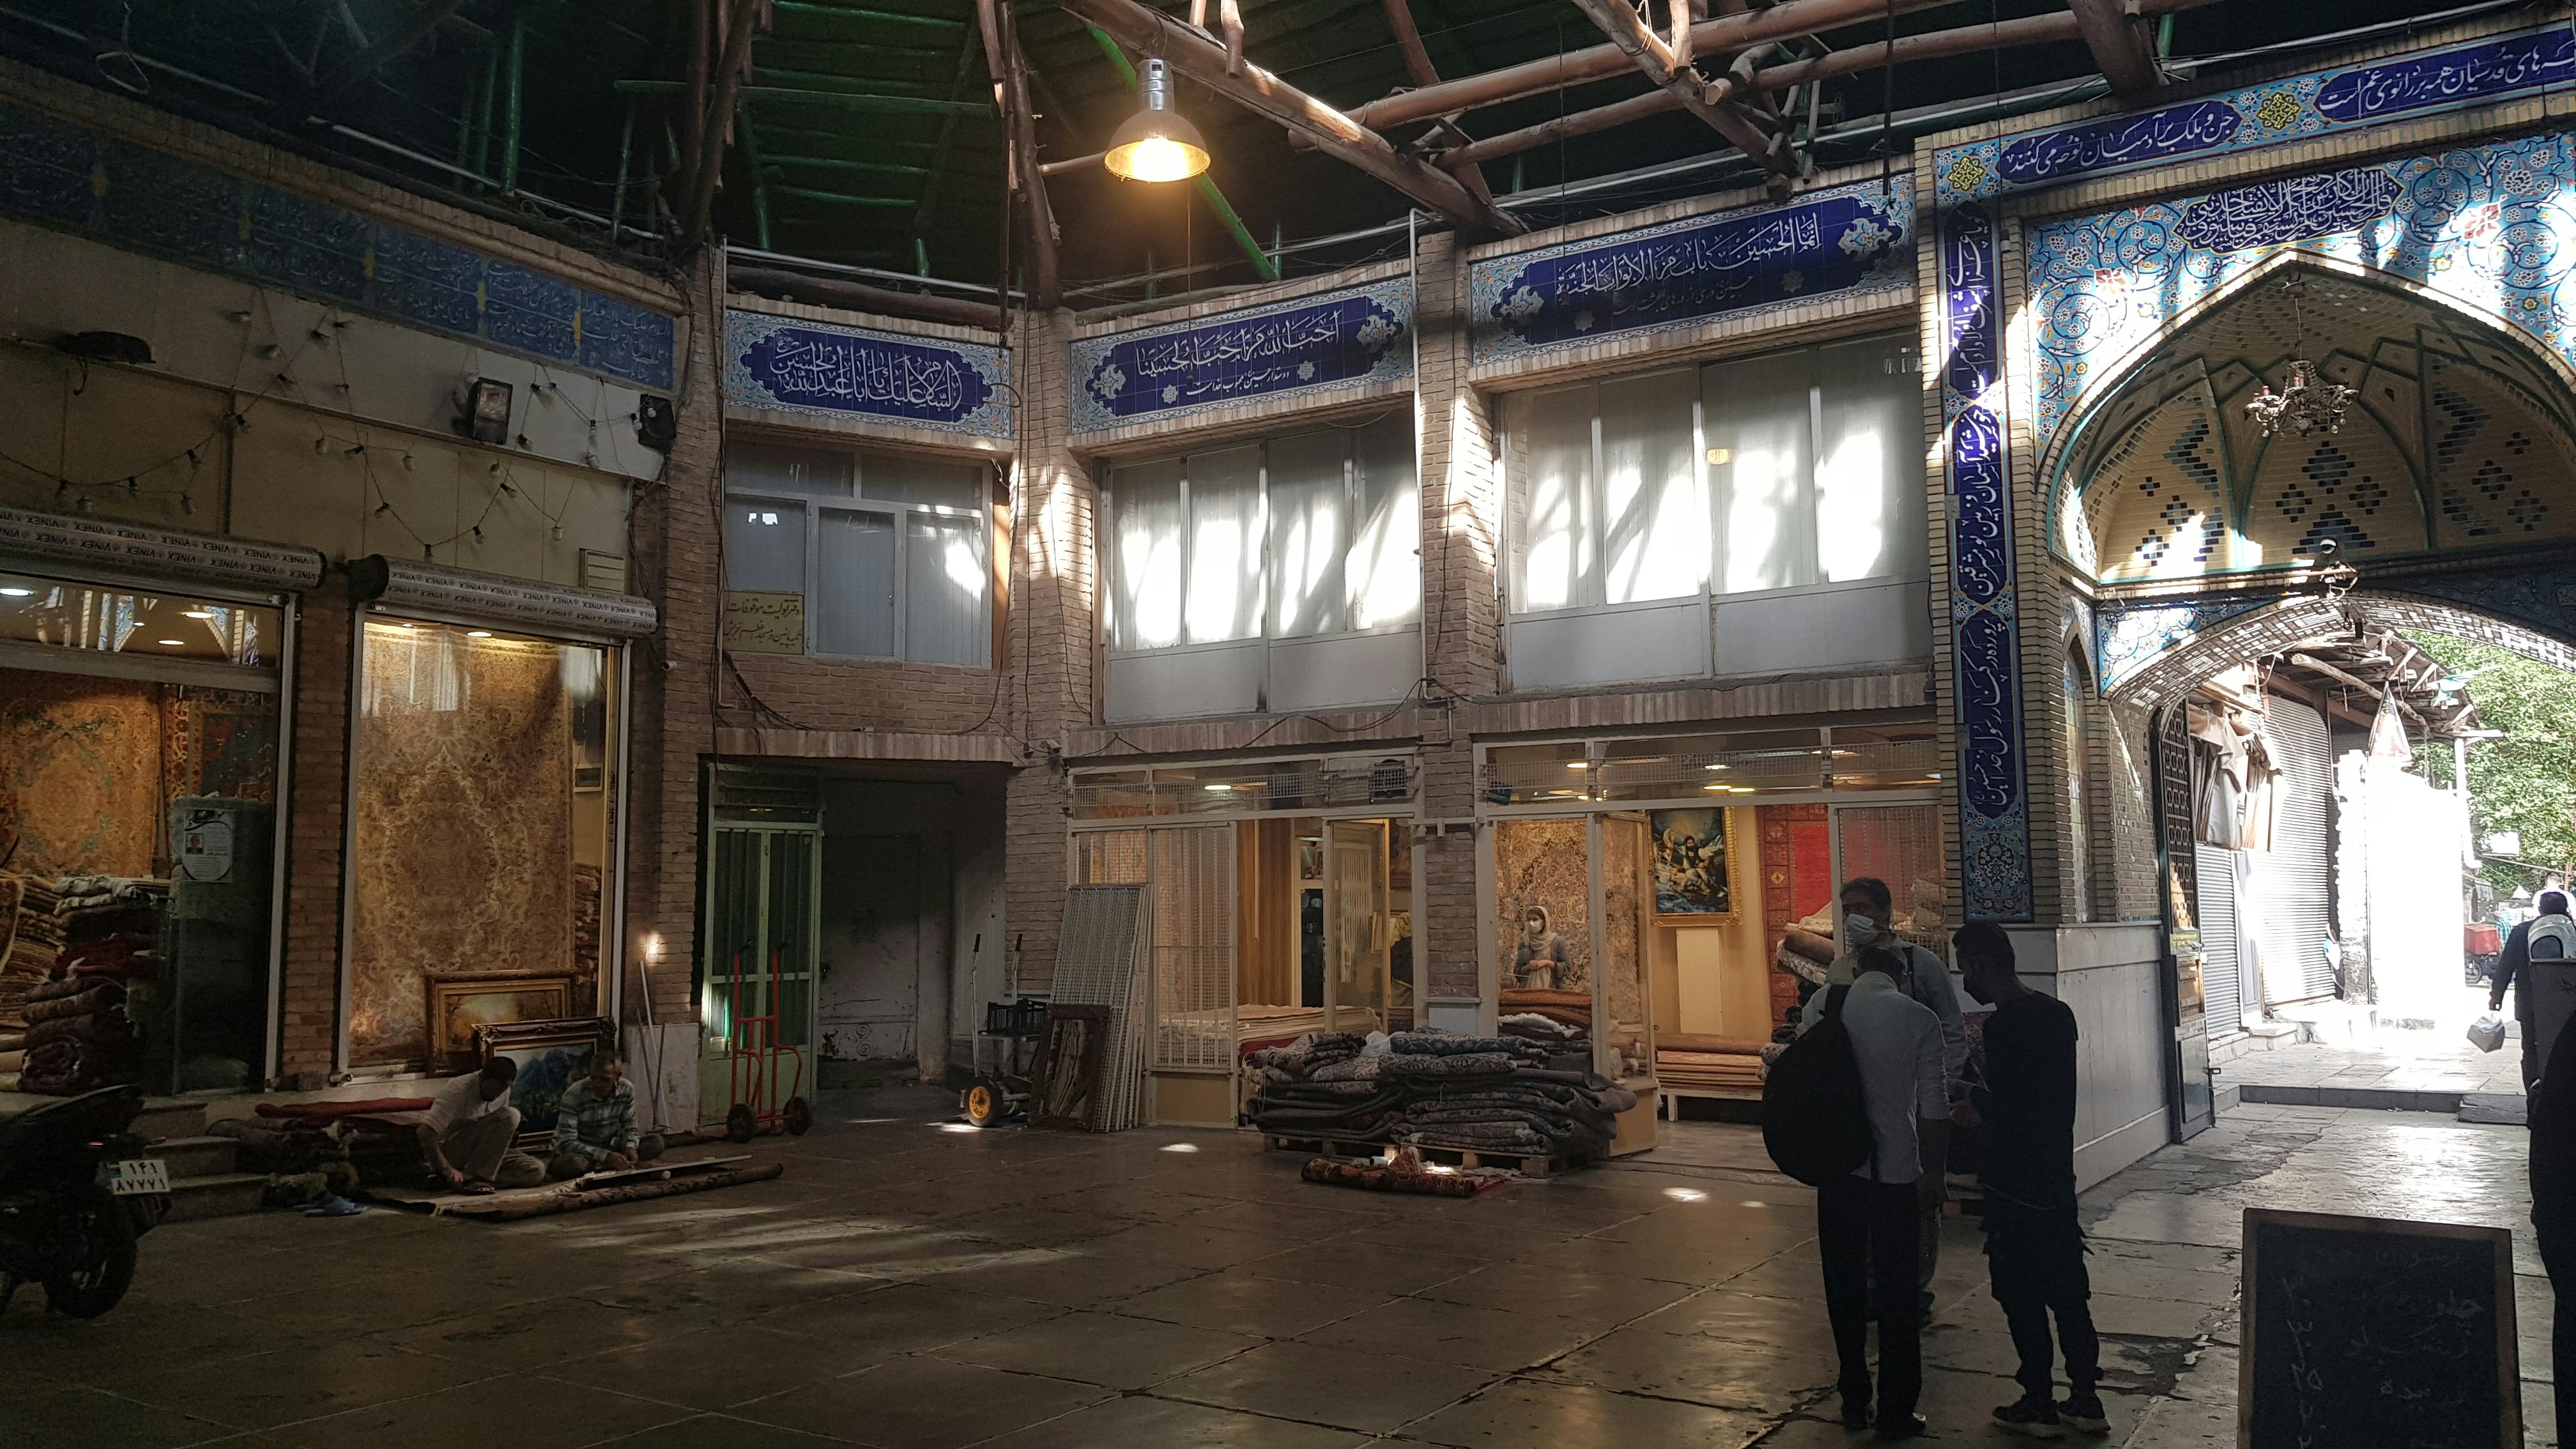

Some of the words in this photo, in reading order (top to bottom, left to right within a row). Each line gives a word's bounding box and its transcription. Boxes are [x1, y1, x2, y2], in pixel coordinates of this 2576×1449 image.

[2365, 72, 2421, 110] زانوی
[2412, 78, 2427, 99] بر
[2425, 66, 2455, 90] همه
[2442, 54, 2504, 94] قدسیان
[2319, 77, 2360, 111] است
[2359, 70, 2383, 118] غم
[2158, 102, 2209, 147] ملک
[2202, 114, 2234, 142] جن
[2204, 113, 2214, 126] و
[2055, 135, 2083, 164] نوحه
[2082, 111, 2167, 167] آدمیان
[1669, 238, 1708, 276] باب
[1708, 217, 1796, 270] الحسین
[868, 352, 931, 406] علیک
[1186, 378, 1222, 395] خداست
[1223, 374, 1245, 392] محبوب
[1243, 368, 1272, 389] حسین
[1266, 366, 1289, 382] دوستدار
[1959, 410, 1998, 462] خورشید
[1958, 450, 1997, 503] آسمان
[27, 516, 59, 528] VINEX
[75, 524, 105, 533] VINEX
[118, 529, 147, 540] VINEX
[160, 535, 191, 548] VINEX
[202, 542, 229, 553] VINEX
[244, 549, 272, 560] VINEX
[282, 554, 308, 565] VINEX
[36, 533, 68, 546] VINEX
[81, 540, 111, 551] VINEX
[128, 546, 156, 557] VINEX
[167, 552, 196, 564] VINEX
[210, 558, 238, 569] VINEX
[250, 564, 276, 575] VINEX
[289, 570, 316, 581] VINEX
[1959, 535, 1995, 560] نور
[1958, 549, 2002, 596] مشرقین
[392, 572, 415, 581] VINEX
[425, 577, 447, 586] VINEX
[459, 583, 481, 591] VINEX
[490, 588, 512, 597] VINEX
[523, 592, 544, 601] VINEX
[552, 596, 573, 605] VINEX
[583, 601, 604, 610] VINEX
[611, 606, 631, 614] VINEX
